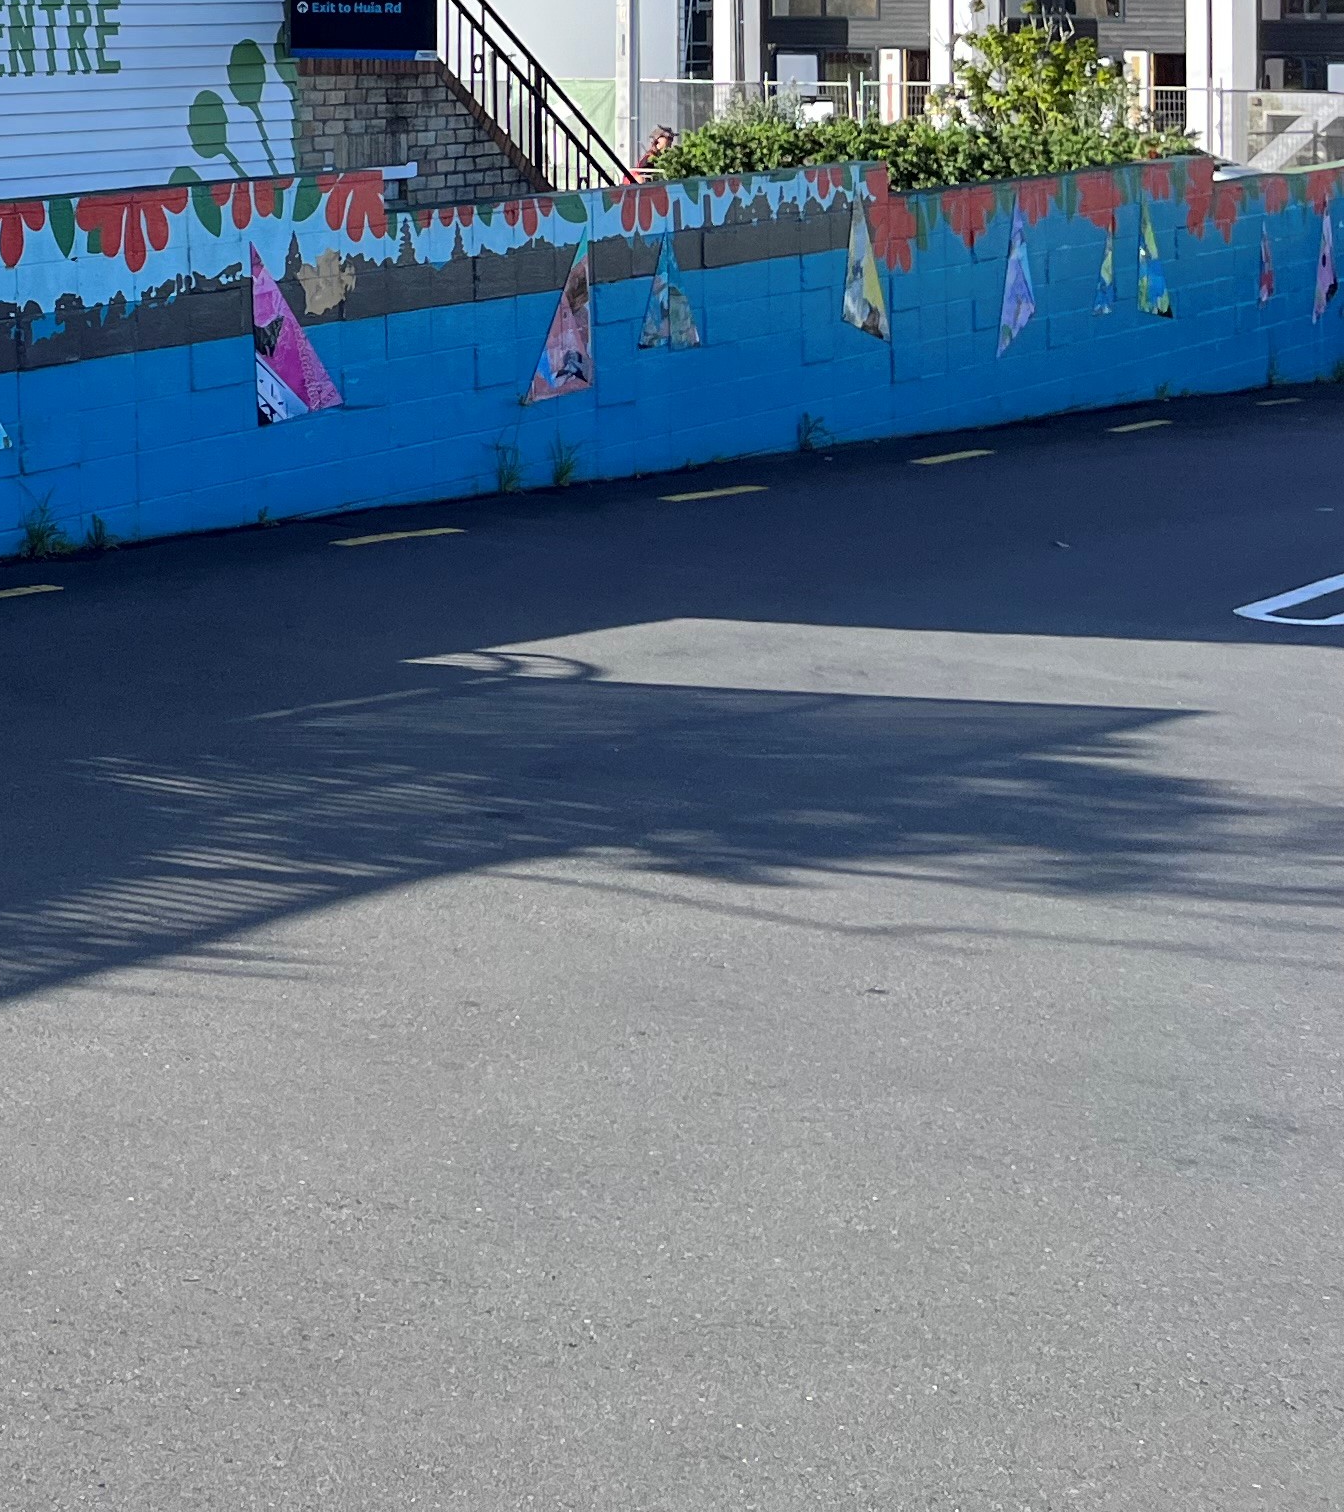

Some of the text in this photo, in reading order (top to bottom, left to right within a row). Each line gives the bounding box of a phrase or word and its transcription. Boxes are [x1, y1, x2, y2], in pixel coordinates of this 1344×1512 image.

[312, 1, 402, 13] Exit to Huia Rd
